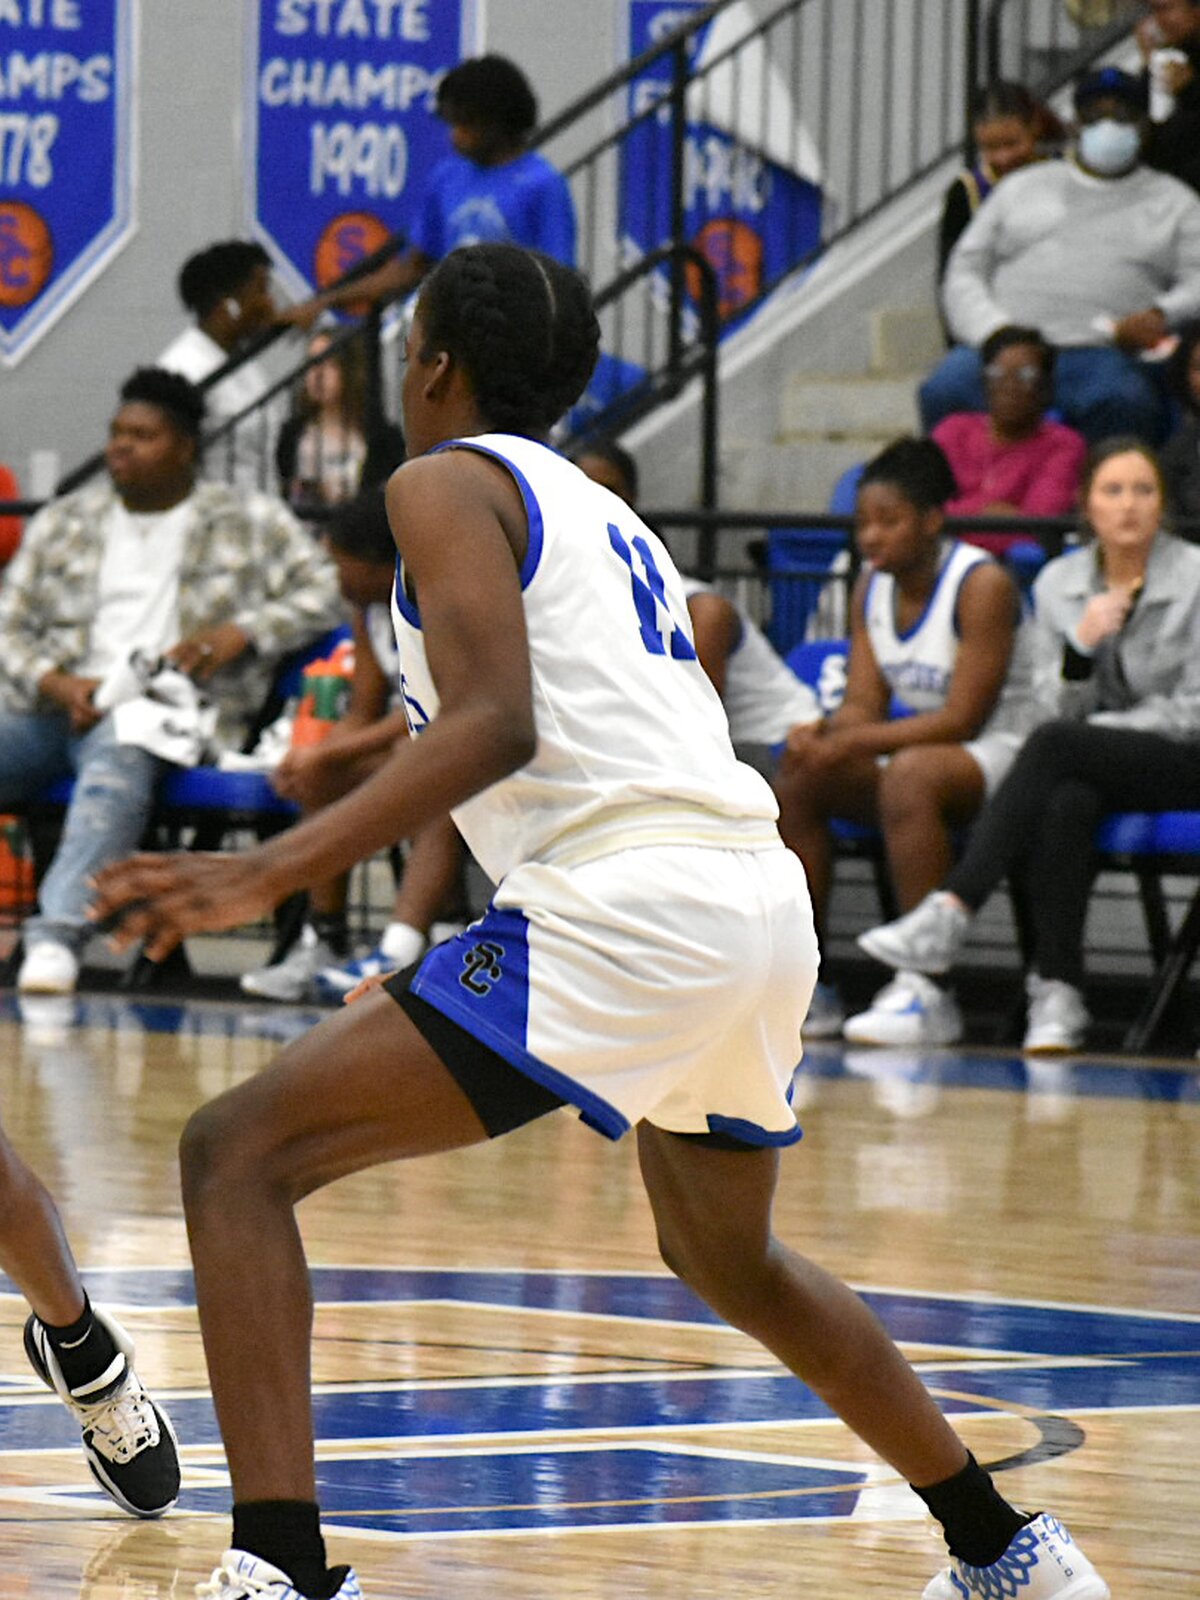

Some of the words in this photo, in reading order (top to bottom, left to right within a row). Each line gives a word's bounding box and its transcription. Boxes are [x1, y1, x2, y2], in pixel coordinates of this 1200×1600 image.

[274, 0, 430, 41] STATE
[310, 121, 408, 198] 1990
[606, 522, 697, 661] 11
